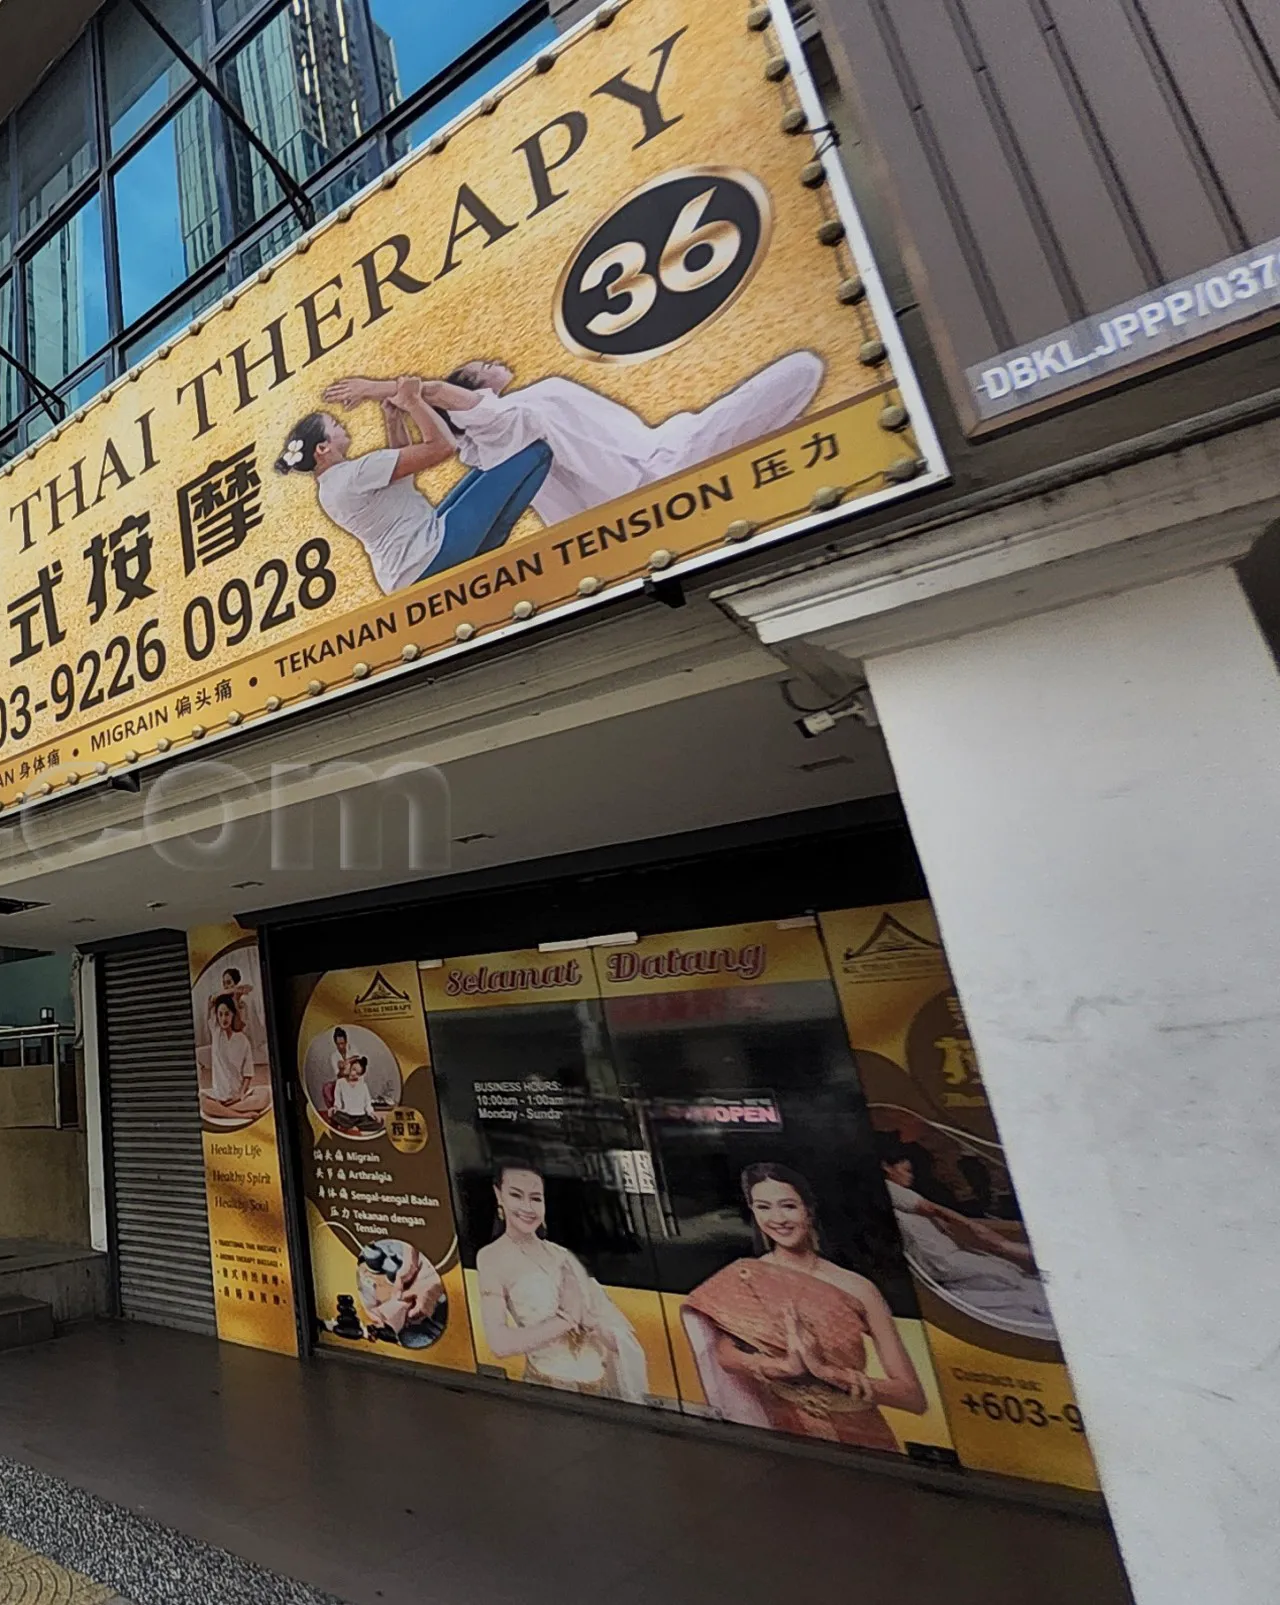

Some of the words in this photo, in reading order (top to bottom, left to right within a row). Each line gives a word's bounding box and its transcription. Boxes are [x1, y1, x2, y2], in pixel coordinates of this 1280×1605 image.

[578, 186, 742, 338] 36
[10, 410, 161, 555] THAI
[176, 24, 690, 441] THERAPY
[980, 250, 1280, 400] DBKL_JPPP/037
[18, 747, 60, 780] 身体痛
[90, 705, 169, 753] MIGRAIN
[174, 678, 233, 719] 偏头痛
[274, 611, 398, 678] TEKANAN
[406, 551, 544, 627] DENGAN
[551, 474, 734, 567] TENSION
[752, 431, 840, 490] 压力
[183, 536, 337, 663] 0928
[444, 958, 582, 997] Selamat
[607, 943, 767, 983] Datang
[474, 1081, 522, 1092] BUSINESS
[476, 1095, 518, 1106] 10:00am
[527, 1094, 564, 1106] 1:00am
[478, 1108, 518, 1122] Monday
[715, 1106, 778, 1124] OPEN
[211, 1143, 243, 1158] Healthy
[245, 1145, 262, 1159] Life
[346, 1151, 380, 1163] Migrain
[212, 1170, 245, 1186] Healthy
[247, 1172, 271, 1187] Spirit
[348, 1170, 393, 1184] Arthralgia
[250, 1199, 269, 1213] Soul
[351, 1190, 409, 1206] Sengal-sengal
[411, 1195, 440, 1207] Badan
[352, 1209, 389, 1221] Tekanan
[390, 1212, 425, 1226] dengan
[354, 1222, 388, 1235] Tension
